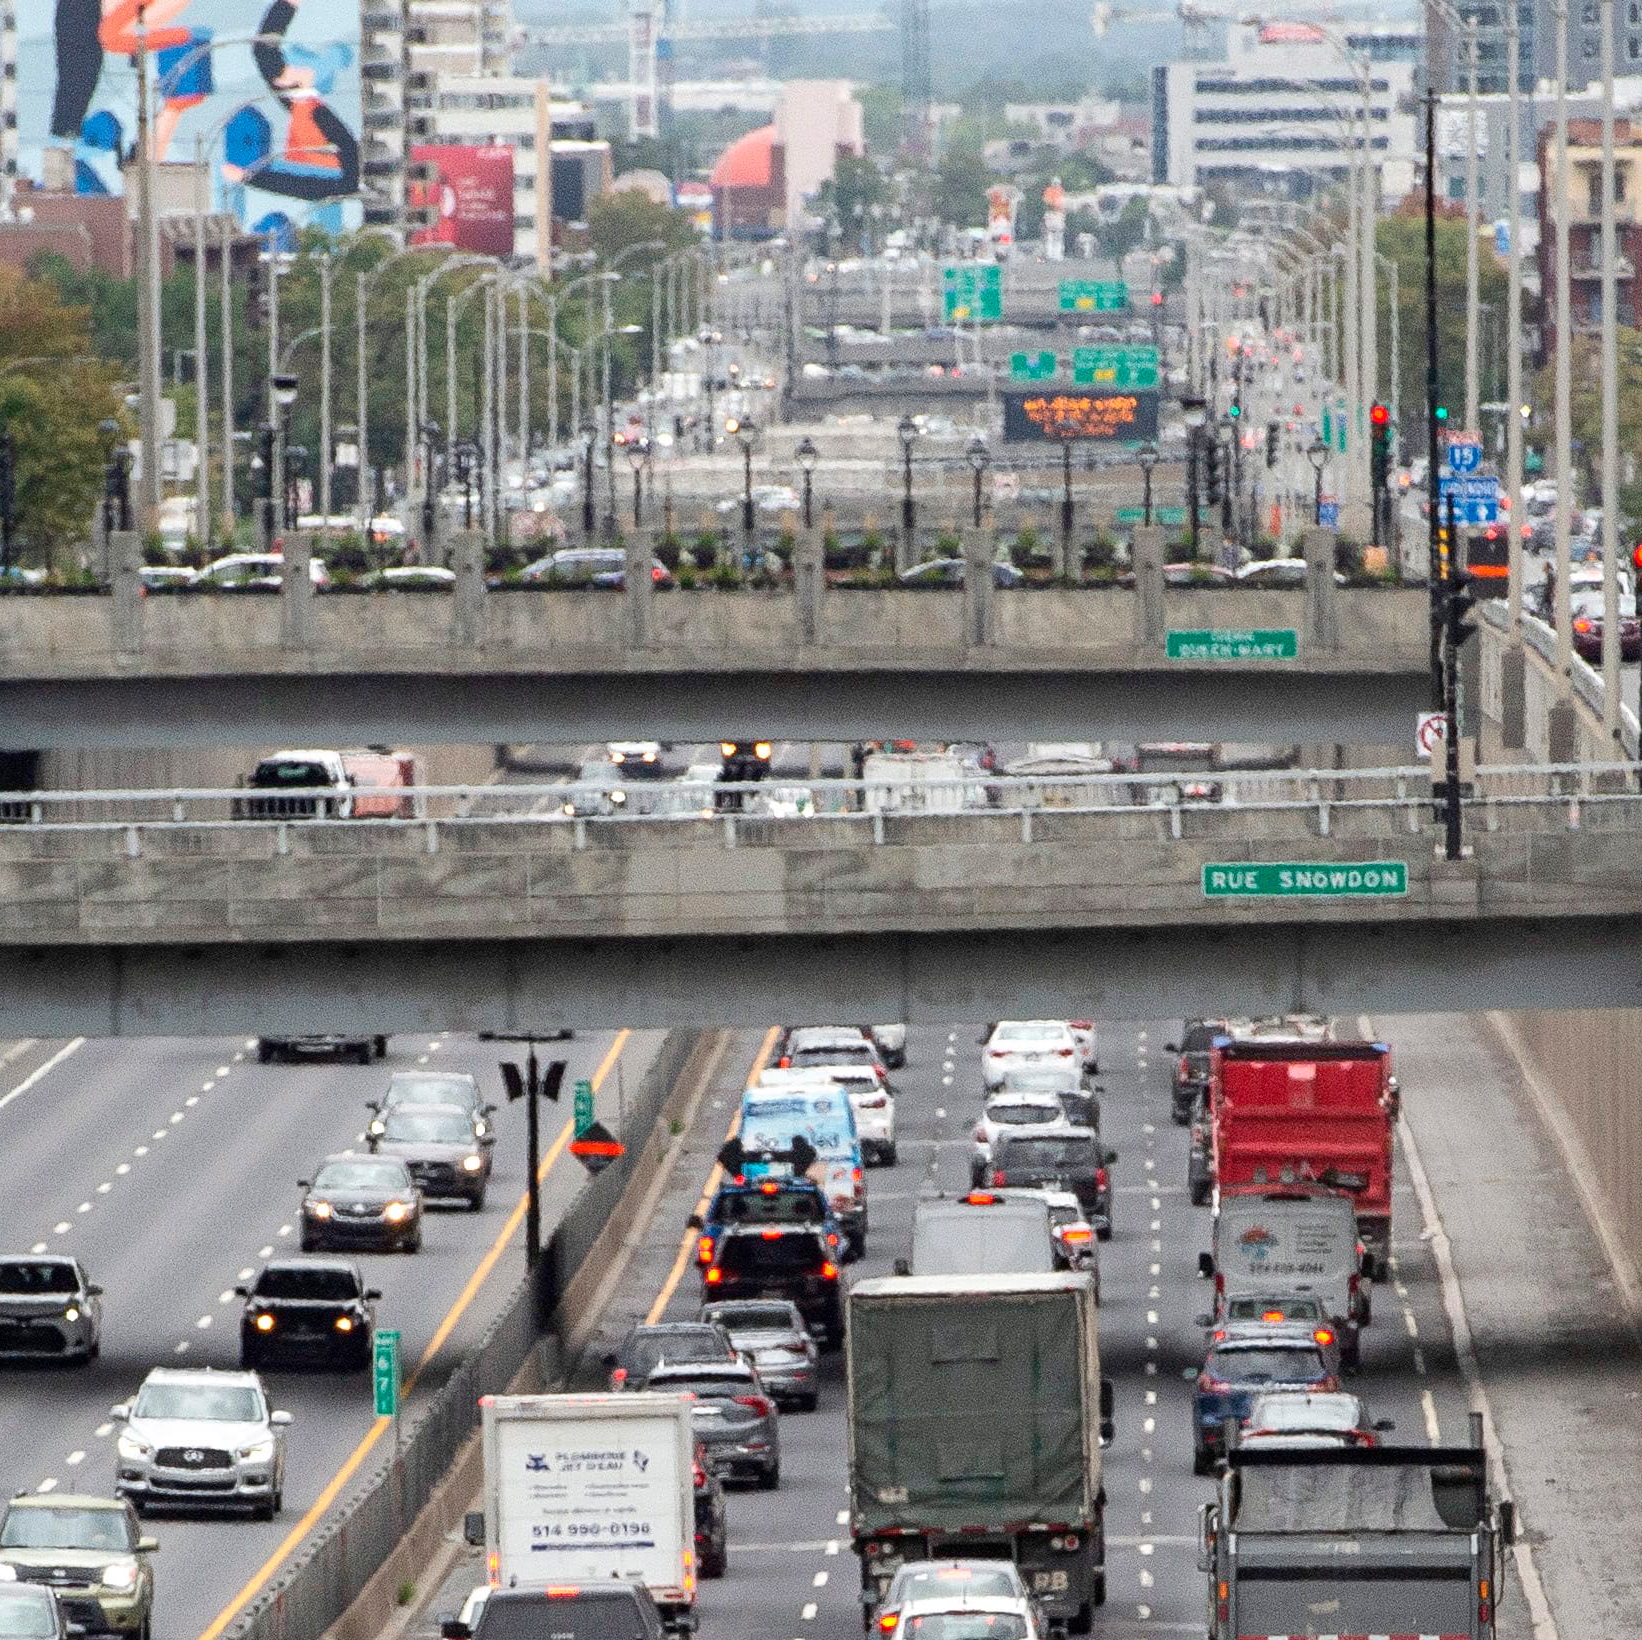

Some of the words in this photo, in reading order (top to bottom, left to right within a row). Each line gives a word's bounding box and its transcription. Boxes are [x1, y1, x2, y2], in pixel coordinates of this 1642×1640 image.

[1454, 447, 1473, 465] 15
[1212, 871, 1258, 889] RUE
[1279, 870, 1399, 888] SNOWDON
[533, 1524, 562, 1537] 514
